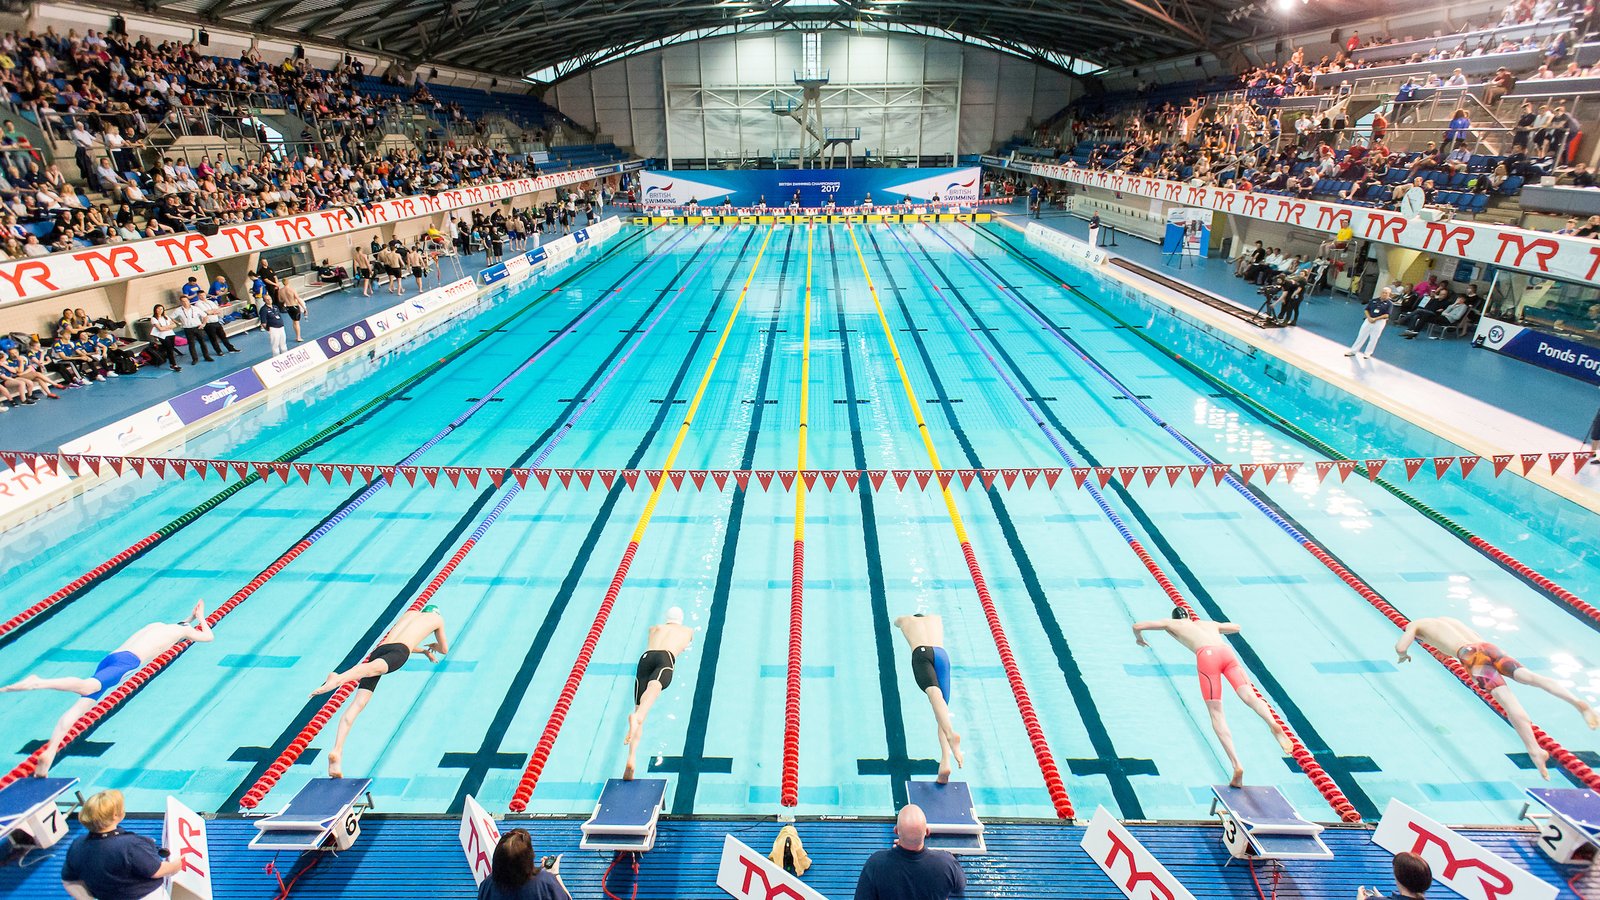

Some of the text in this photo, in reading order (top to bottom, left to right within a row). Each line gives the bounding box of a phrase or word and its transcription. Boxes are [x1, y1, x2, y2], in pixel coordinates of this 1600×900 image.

[1060, 168, 1069, 179] TYR
[1071, 170, 1081, 182] TYR
[1083, 172, 1093, 184] TYR
[1096, 174, 1108, 187] TYR
[1111, 175, 1123, 190] TYR
[1126, 178, 1140, 193] TYR
[1145, 180, 1160, 197] TYR
[1165, 184, 1182, 201] TYR
[1188, 187, 1206, 206] TYR
[1214, 191, 1235, 211] TYR
[1244, 195, 1267, 218] TYR
[1276, 201, 1306, 224] TYR
[1316, 207, 1352, 231] TYR
[1365, 213, 1407, 243] TYR
[1423, 222, 1475, 256] TYR
[1494, 233, 1559, 272] TYR
[0, 261, 60, 297] YR
[72, 246, 145, 282] TYR
[155, 234, 214, 266] TYR
[221, 224, 269, 253] TYR
[275, 216, 315, 242] TYR
[320, 210, 354, 232] TYR
[362, 204, 387, 224] TYR
[391, 199, 416, 218] TYR
[419, 196, 441, 212] TYR
[444, 191, 463, 208] TYR
[465, 188, 483, 203] TYR
[485, 185, 501, 200] TYR
[502, 182, 517, 196] TYR
[518, 180, 531, 192] TYR
[531, 177, 544, 190] TYR
[545, 175, 556, 187] TYR
[557, 174, 567, 184] TYR
[271, 348, 311, 373] Sheffield
[1537, 342, 1576, 363] Ponds
[201, 385, 237, 404] Strathmore
[11, 463, 58, 490] TYR
[43, 810, 57, 834] 7
[345, 812, 357, 835] 6
[1226, 821, 1237, 844] 3
[178, 817, 205, 877] TYR
[469, 816, 492, 879] TY
[1542, 825, 1563, 851] 2
[1408, 821, 1514, 900] TYR
[739, 855, 806, 900] TY
